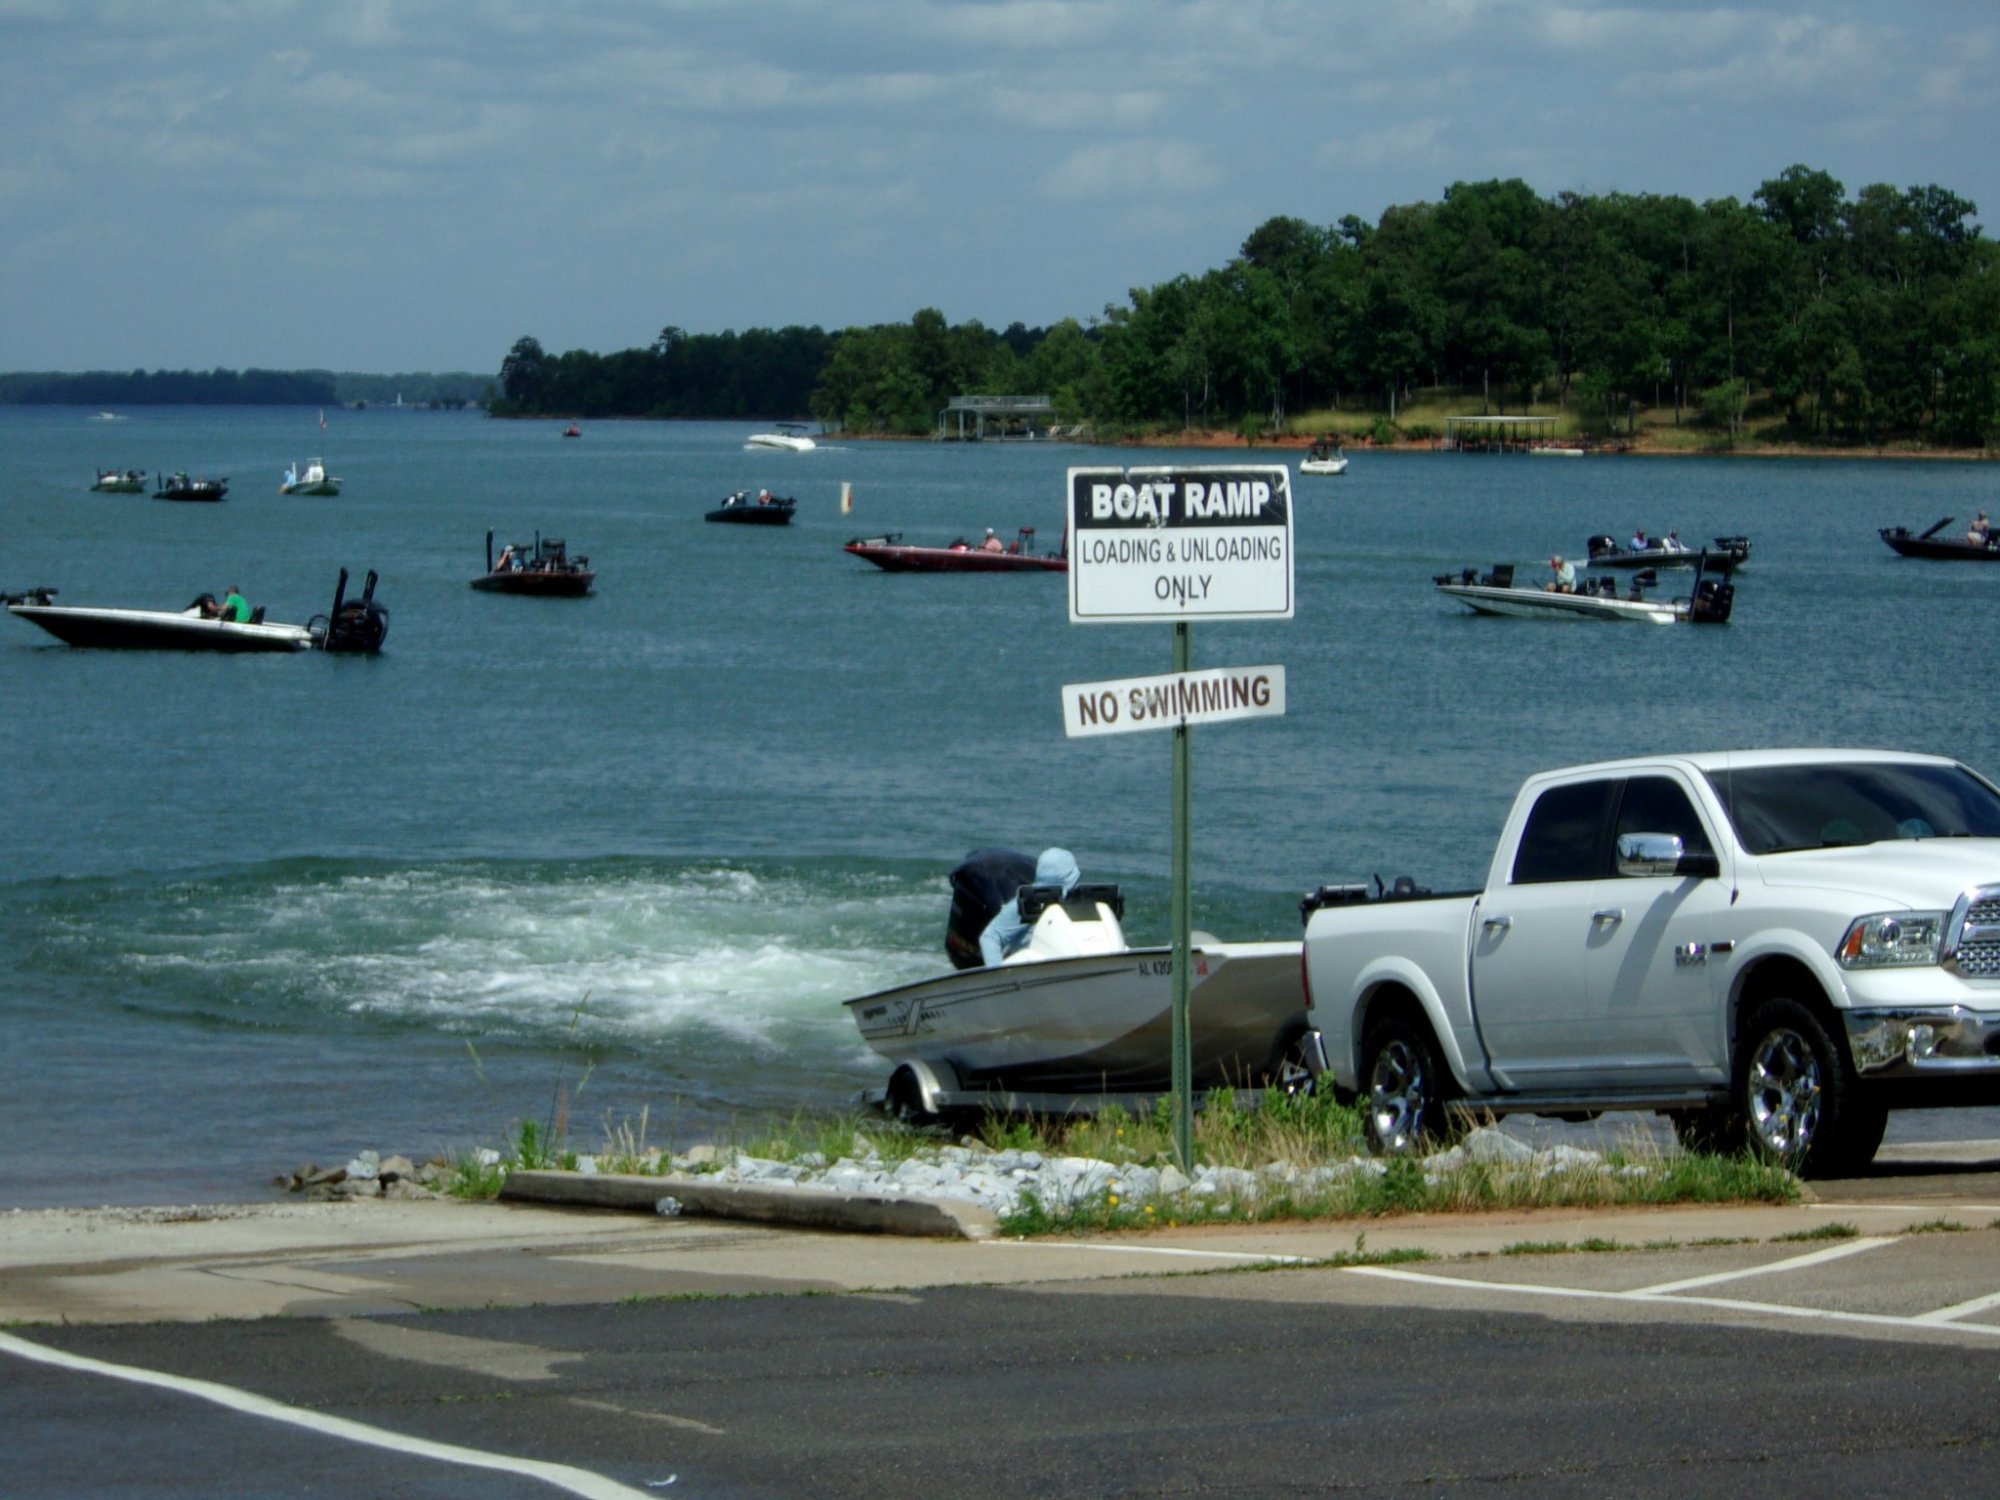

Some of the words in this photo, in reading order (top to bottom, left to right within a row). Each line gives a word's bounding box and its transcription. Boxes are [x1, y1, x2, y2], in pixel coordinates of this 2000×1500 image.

[1092, 483, 1175, 519] BOAT
[1184, 481, 1270, 518] RAMP
[1083, 539, 1161, 564] LOADING
[1167, 542, 1176, 562] &
[1181, 536, 1281, 562] UNLOADING
[1155, 574, 1212, 600] ONLY
[1078, 691, 1118, 726] NO
[1129, 675, 1270, 721] SWIMMING
